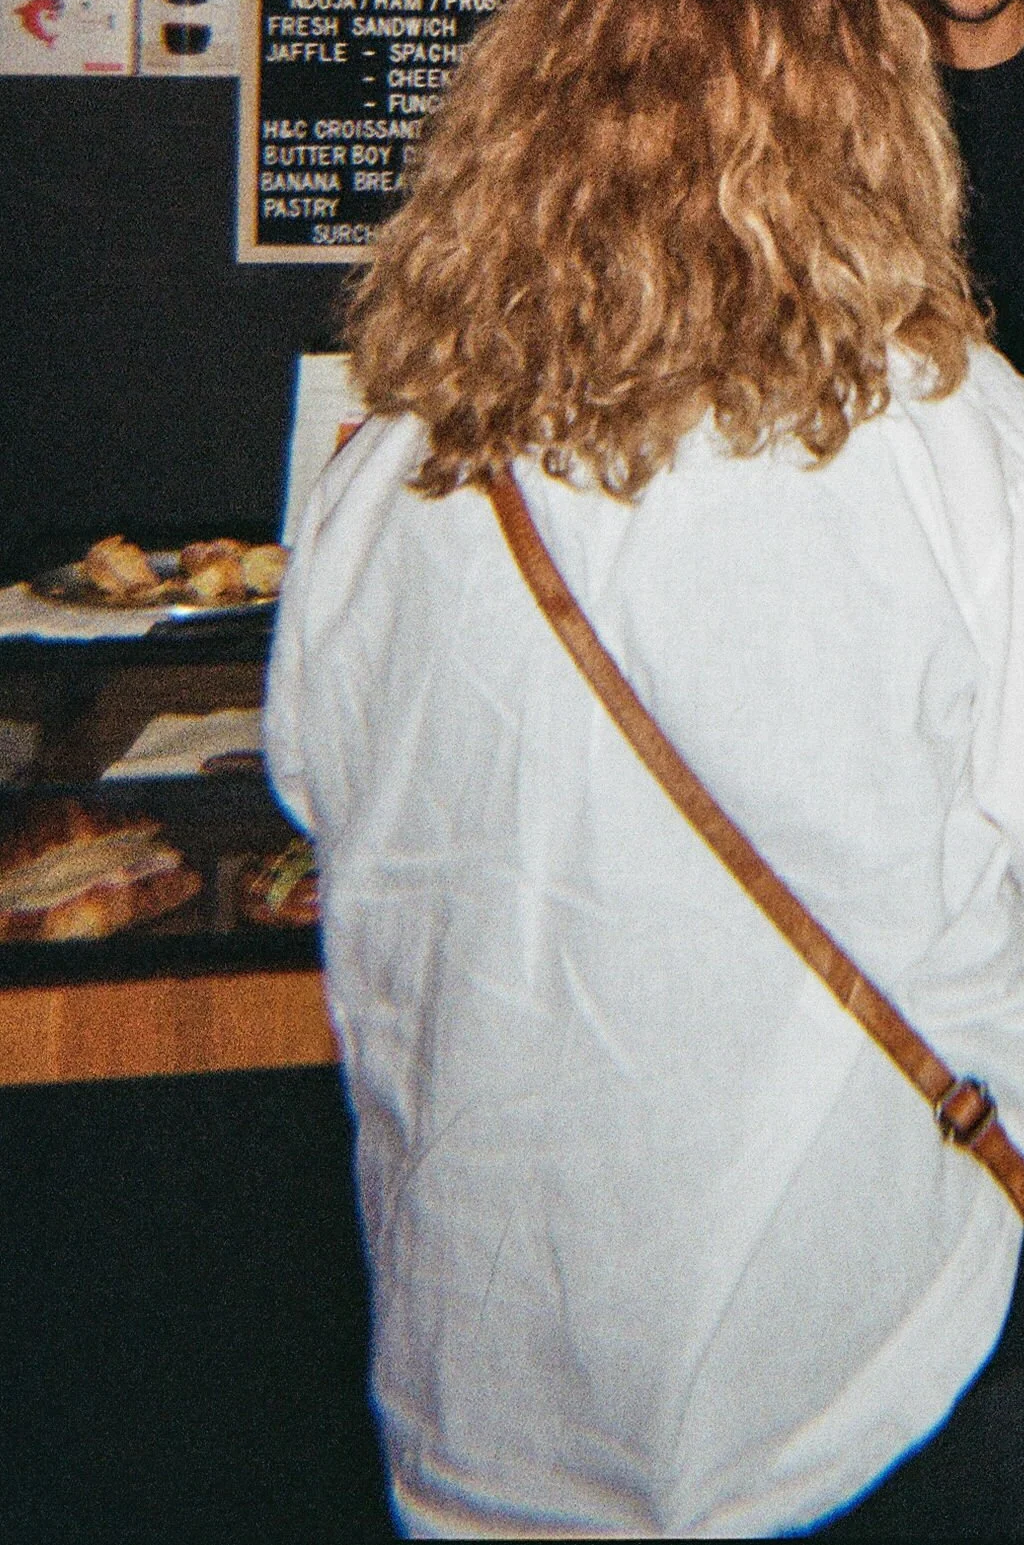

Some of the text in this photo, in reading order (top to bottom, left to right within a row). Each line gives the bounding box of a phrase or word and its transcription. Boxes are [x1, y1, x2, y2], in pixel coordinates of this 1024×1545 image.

[268, 16, 457, 38] FRESH SANDWICH
[266, 42, 349, 63] JAFFLE
[314, 120, 421, 140] CROISSANT
[264, 145, 347, 166] BUTTER
[351, 145, 393, 165] BOY
[261, 172, 342, 192] BANANA
[263, 199, 341, 219] PASTRY
